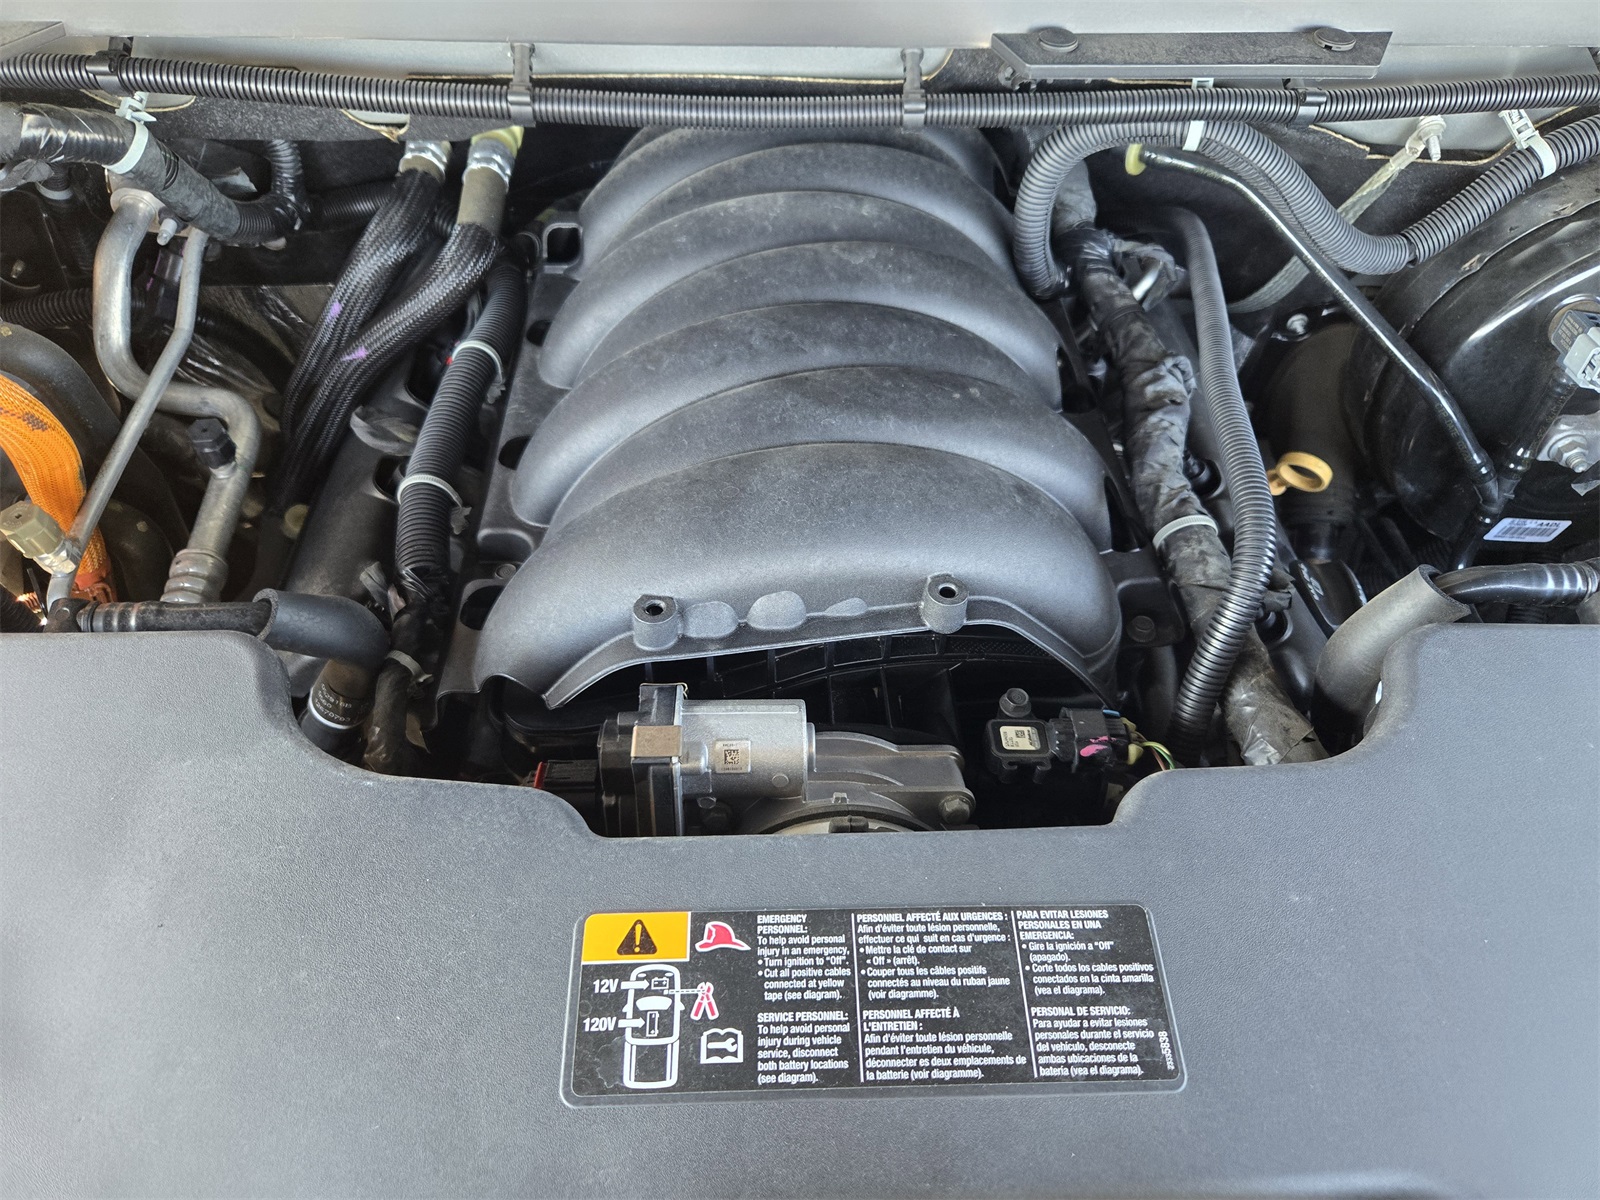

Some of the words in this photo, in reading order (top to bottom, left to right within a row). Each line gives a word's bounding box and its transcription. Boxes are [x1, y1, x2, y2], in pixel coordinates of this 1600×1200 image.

[757, 914, 807, 923] EMERGENCY
[857, 914, 904, 922] PERSONNEL
[906, 911, 941, 921] AFFECTÉ
[943, 912, 959, 921] AUX
[961, 912, 1003, 920] URGENCES
[1016, 911, 1039, 919] PARA
[1040, 910, 1069, 919] EVITAR
[1070, 910, 1108, 918] LESIONES
[757, 925, 807, 934] PERSONNEL:
[858, 925, 873, 933] Afin
[875, 924, 904, 933] d'éviter
[906, 924, 926, 932] toute
[928, 923, 951, 931] lésion
[953, 923, 1000, 933] personnelle,
[1018, 921, 1070, 930] PERSONALES
[1071, 921, 1083, 929] EN
[1084, 920, 1101, 929] UNA
[757, 936, 767, 945] To
[769, 936, 786, 945] help
[788, 935, 809, 944] avoid
[811, 934, 845, 945] personal
[858, 935, 893, 944] effectuer
[907, 935, 919, 944] qui
[923, 934, 938, 942] suit
[967, 933, 1006, 943] d'urgence
[1020, 931, 1074, 940] EMERGENCIA:
[758, 947, 779, 957] injury
[782, 947, 789, 955] in
[803, 947, 849, 955] emergency,
[866, 946, 891, 954] Mettre
[893, 945, 901, 953] la
[902, 945, 914, 953] clé
[916, 945, 926, 953] de
[928, 944, 957, 953] contact
[1029, 942, 1045, 950] Gire
[1046, 942, 1054, 950] la
[1055, 941, 1086, 952] ignición
[764, 958, 782, 966] Turn
[784, 957, 814, 967] ignition
[816, 957, 824, 965] to
[893, 956, 920, 966] (arrêt).
[1030, 953, 1071, 963] (apagado).
[764, 969, 778, 977] Cut
[780, 968, 789, 977] all
[792, 968, 822, 978] positive
[825, 967, 851, 976] cables
[867, 968, 895, 978] Couper
[897, 967, 914, 975] tous
[916, 967, 928, 975] les
[930, 966, 956, 975] câbles
[958, 965, 987, 976] positifs
[1032, 964, 1053, 972] Corte
[1055, 964, 1077, 972] todos
[1078, 963, 1090, 972] los
[1092, 963, 1118, 972] cables
[1119, 963, 1154, 973] positivos
[764, 979, 806, 989] connected
[808, 979, 816, 987] at
[818, 978, 844, 989] yellow
[868, 978, 908, 987] connectés
[923, 977, 949, 986] niveau
[951, 977, 961, 986] du
[963, 977, 986, 985] ruban
[988, 976, 1010, 987] jaune
[1033, 975, 1078, 984] conectados
[1080, 975, 1090, 983] en
[1091, 974, 1099, 983] la
[1101, 974, 1121, 983] cinta
[1122, 973, 1154, 982] amarilla
[593, 979, 618, 993] 12V
[1035, 986, 1052, 996] (vea
[1054, 986, 1061, 994] el
[1063, 985, 1105, 996] diagrama).
[764, 991, 782, 1002] tape
[785, 990, 802, 1001] (see
[804, 990, 842, 1000] diagram).
[868, 990, 886, 1000] (voir
[888, 989, 939, 1000] diagramme).
[758, 1012, 794, 1022] SERVICE
[796, 1011, 848, 1021] PERSONNEL:
[863, 1009, 913, 1019] PERSONNEL
[915, 1007, 951, 1018] AFFECTÉ
[1031, 1007, 1076, 1016] PERSONAL
[1077, 1006, 1089, 1016] DE
[1090, 1006, 1131, 1015] SERVICIO:
[583, 1017, 616, 1031] 120V
[757, 1025, 768, 1034] To
[770, 1025, 788, 1035] help
[790, 1023, 812, 1033] avoid
[814, 1023, 850, 1034] personal
[863, 1021, 918, 1031] L'ENTRETIEN
[1033, 1019, 1052, 1028] Para
[1053, 1018, 1081, 1030] ayudar
[1090, 1018, 1113, 1027] evitar
[1114, 1018, 1148, 1027] lesiones
[864, 1034, 881, 1043] Afin
[883, 1033, 914, 1043] d'éviter
[916, 1033, 937, 1042] toute
[939, 1032, 963, 1041] lésion
[965, 1031, 1013, 1043] personnelle
[1035, 1030, 1079, 1041] personales
[1081, 1030, 1112, 1039] durante
[1113, 1030, 1121, 1038] el
[1123, 1029, 1154, 1038] servicio
[758, 1037, 781, 1048] injury
[783, 1036, 810, 1047] during
[812, 1035, 841, 1045] vehicle
[1037, 1042, 1049, 1052] del
[1089, 1041, 1135, 1051] desconecte
[758, 1048, 790, 1058] service,
[793, 1047, 838, 1057] disconnect
[865, 1045, 899, 1057] pendant
[901, 1044, 942, 1054] l'entretien
[945, 1044, 955, 1054] du
[957, 1043, 994, 1054] véhicule,
[866, 1057, 917, 1068] déconnecter
[931, 1057, 952, 1066] deux
[953, 1055, 1014, 1067] emplacements
[1016, 1055, 1027, 1064] de
[1038, 1054, 1066, 1064] ambas
[1068, 1054, 1116, 1063] ubicaciones
[1117, 1053, 1128, 1062] de
[1130, 1053, 1138, 1062] la
[758, 1061, 777, 1071] both
[779, 1060, 809, 1071] battery
[811, 1059, 849, 1069] locations
[1070, 1065, 1088, 1077] (vea
[1090, 1065, 1098, 1075] el
[1099, 1064, 1144, 1077] diagrama).
[758, 1073, 776, 1085] (see
[778, 1072, 818, 1084] diagram).
[866, 1070, 874, 1080] la
[876, 1069, 909, 1080] batterie
[911, 1069, 930, 1080] (voir
[931, 1068, 984, 1080] diagramme).
